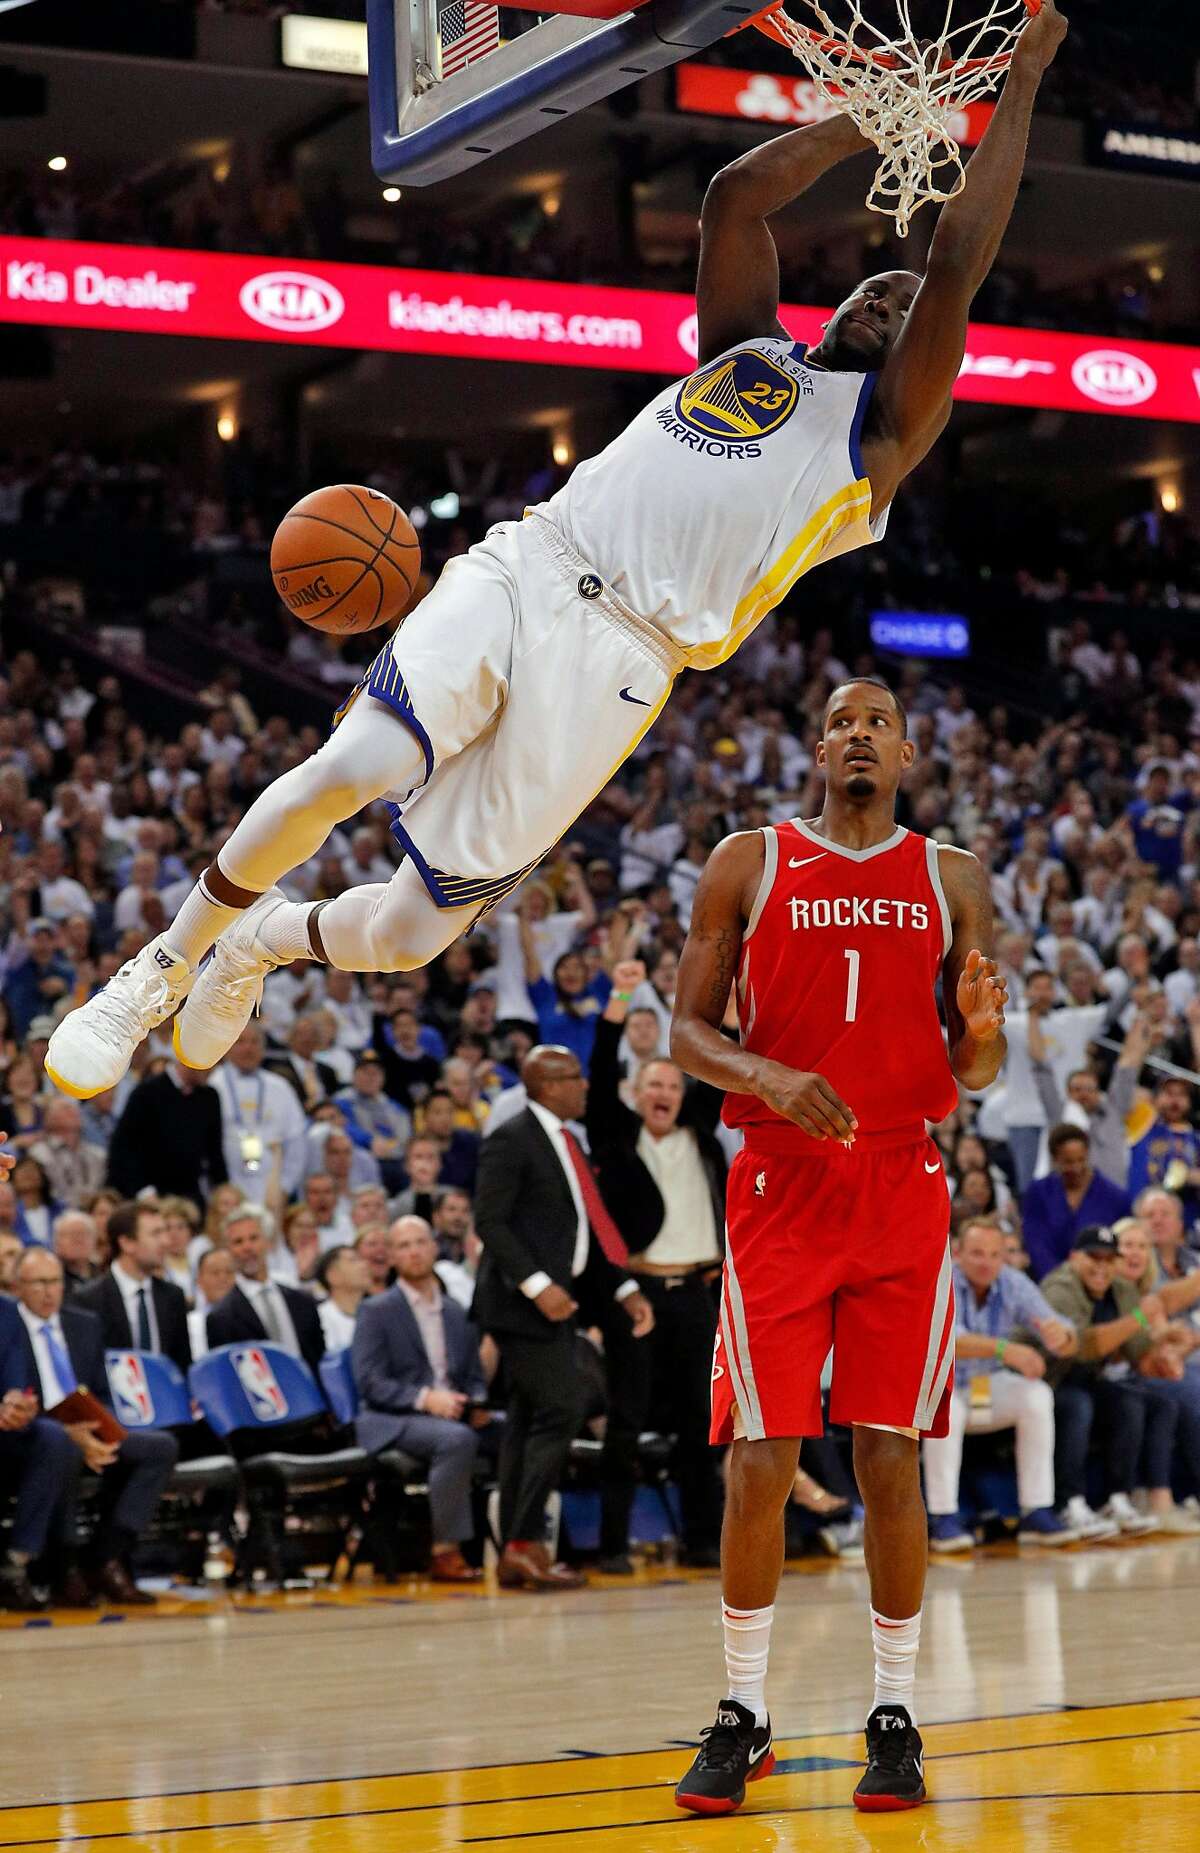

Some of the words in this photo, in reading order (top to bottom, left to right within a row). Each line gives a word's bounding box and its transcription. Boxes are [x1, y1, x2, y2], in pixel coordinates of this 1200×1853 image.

[6, 260, 68, 303] Kia
[74, 265, 196, 312] Dealer
[257, 285, 328, 322] KIA
[388, 291, 643, 350] kiadealers.com
[739, 382, 790, 411] 23
[789, 366, 814, 396] STATE
[656, 404, 762, 459] WARRIORS
[786, 895, 929, 931] ROCKETS
[844, 949, 860, 1022] 1
